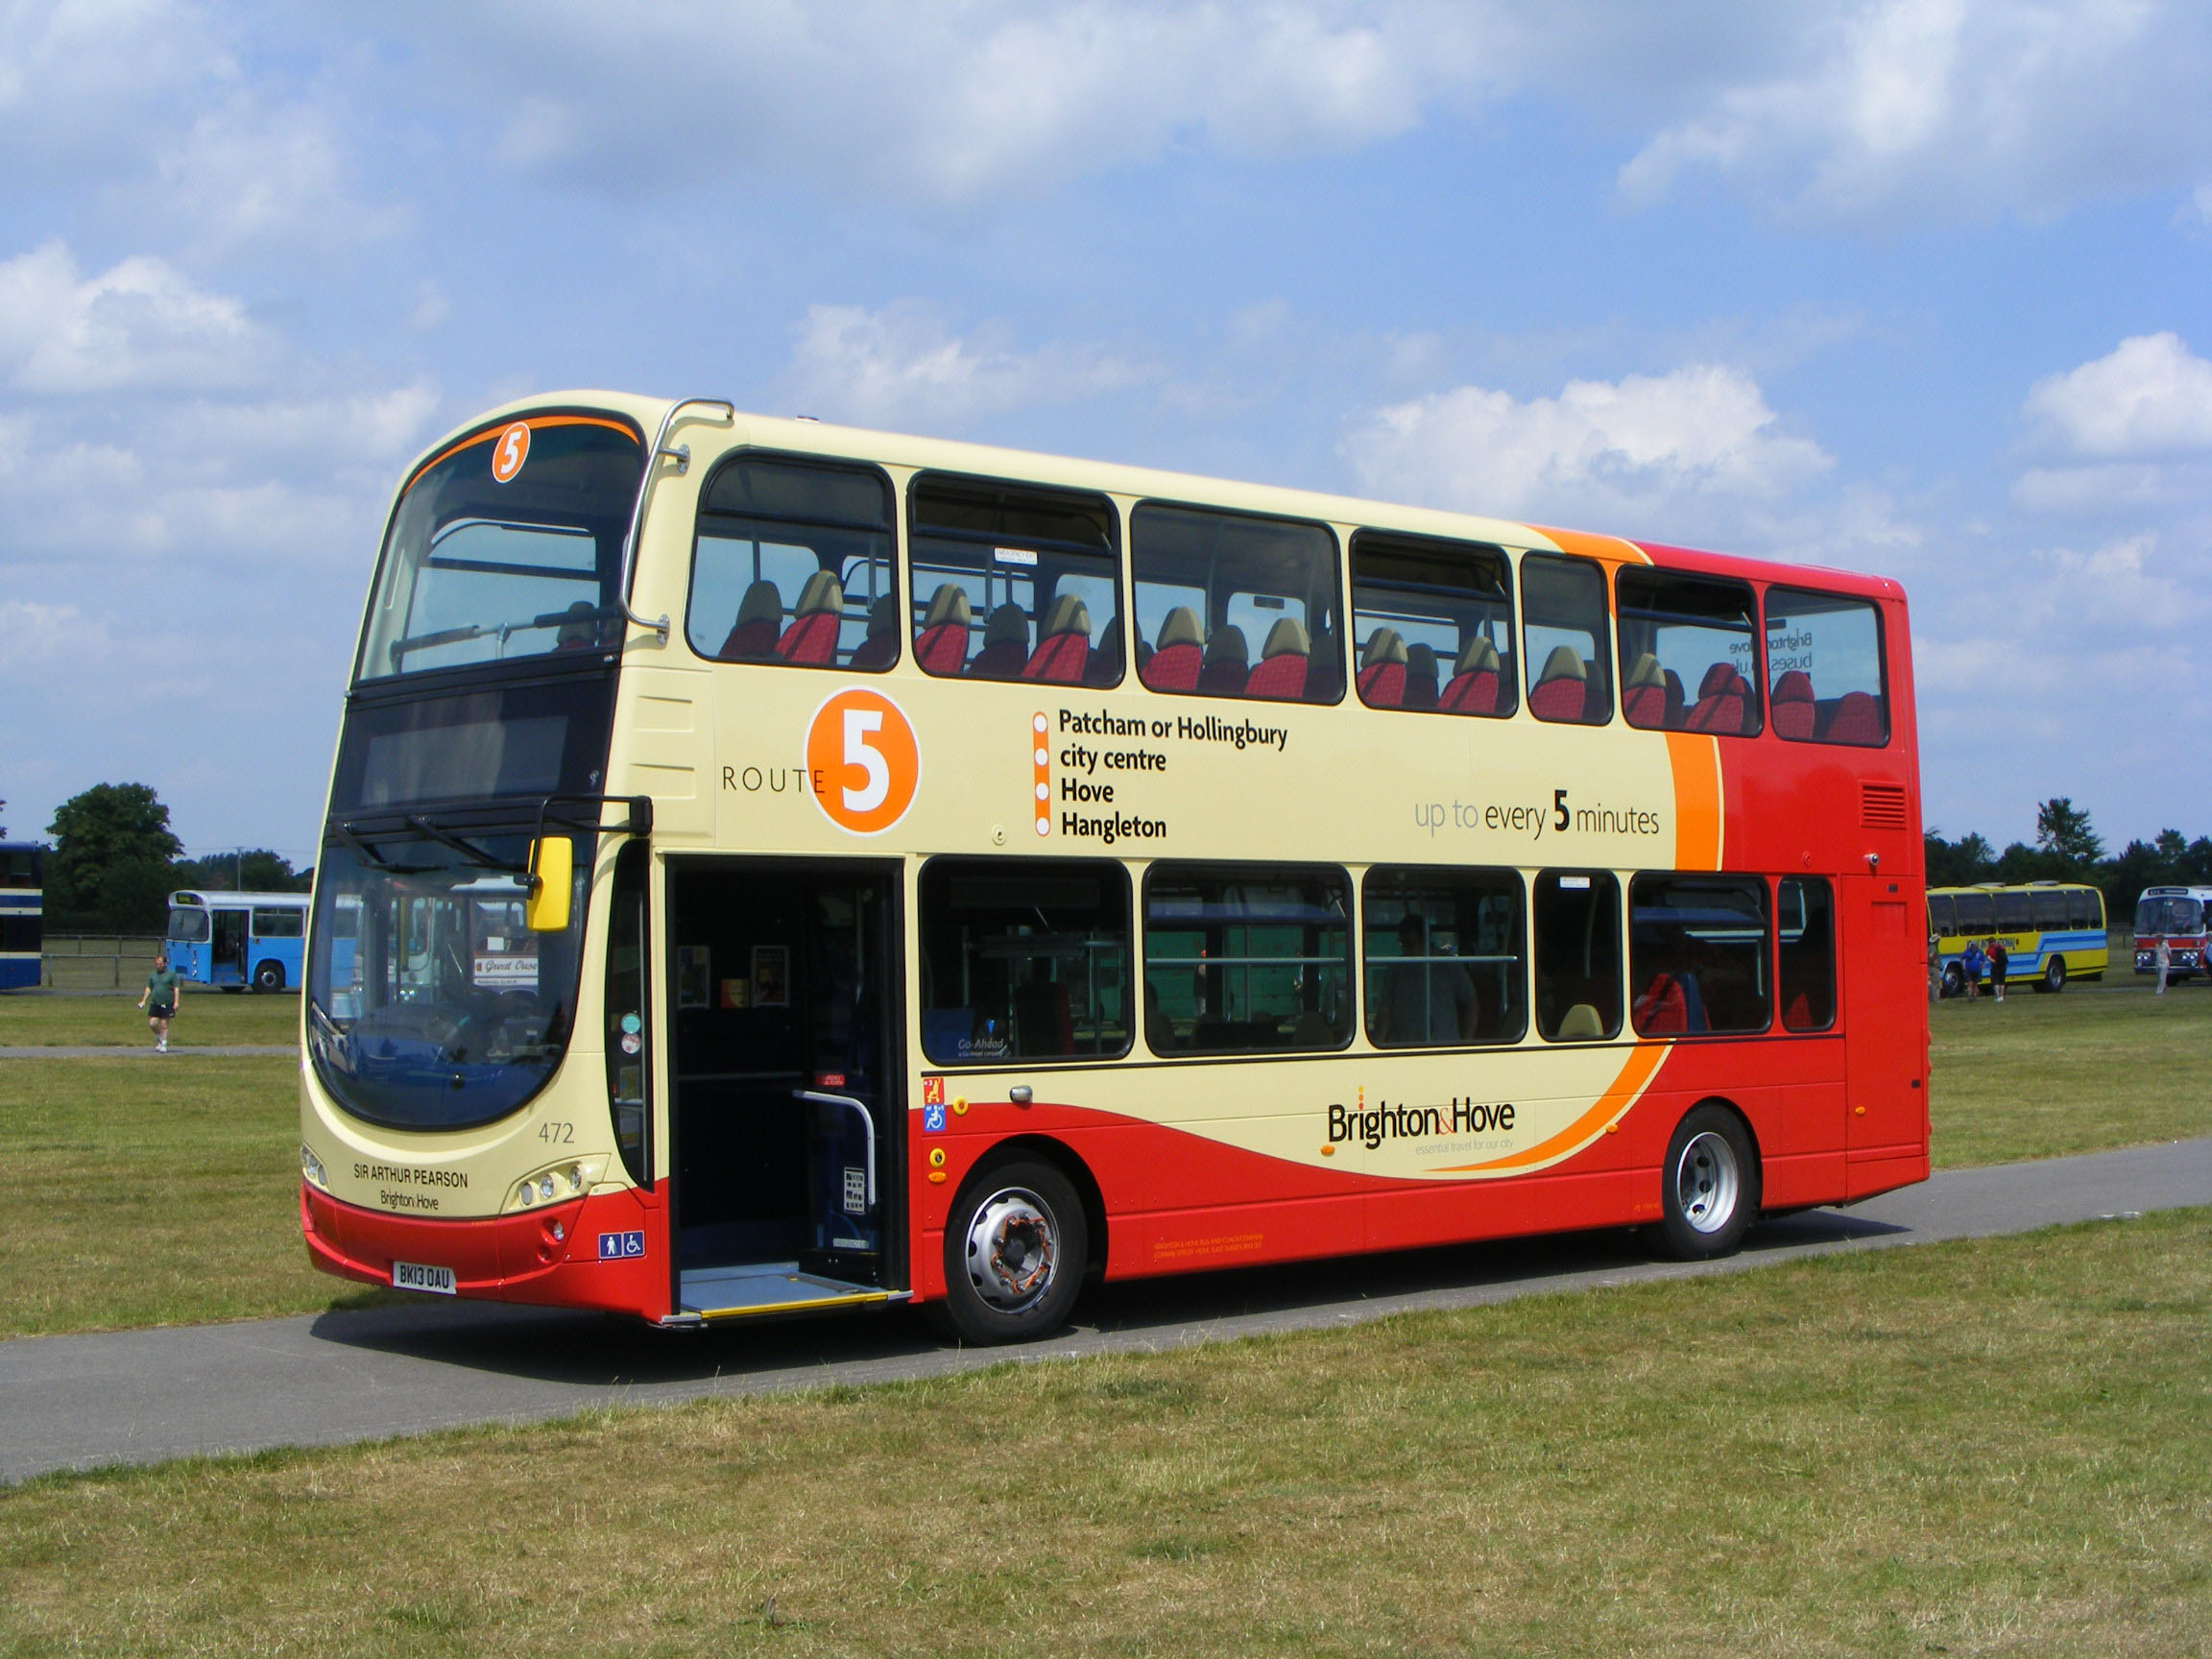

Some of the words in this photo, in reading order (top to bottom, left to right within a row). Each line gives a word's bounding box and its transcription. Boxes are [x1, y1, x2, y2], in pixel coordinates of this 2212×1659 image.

[500, 430, 523, 474] 5
[1059, 709, 1146, 737] Patcham
[1151, 720, 1172, 738] or
[1178, 715, 1288, 753] Hollingbury
[723, 766, 826, 794] ROUTE
[842, 709, 890, 812] 5
[1060, 743, 1098, 775] city
[1104, 749, 1166, 771] centre
[1061, 778, 1114, 803] Hove
[1062, 811, 1166, 845] Hangleton
[1415, 803, 1445, 838] up
[1452, 800, 1479, 829] to
[1485, 805, 1547, 841] every
[1554, 789, 1571, 831] 5
[1576, 803, 1660, 834] minutes
[539, 1122, 575, 1143] 472
[1415, 1142, 1449, 1156] essential
[1451, 1140, 1472, 1152] travel
[353, 1164, 369, 1179] SIR
[371, 1166, 412, 1184] ARTHUR
[414, 1168, 469, 1189] PEARSON
[399, 1264, 424, 1286] BK13
[427, 1268, 449, 1288] OAU
